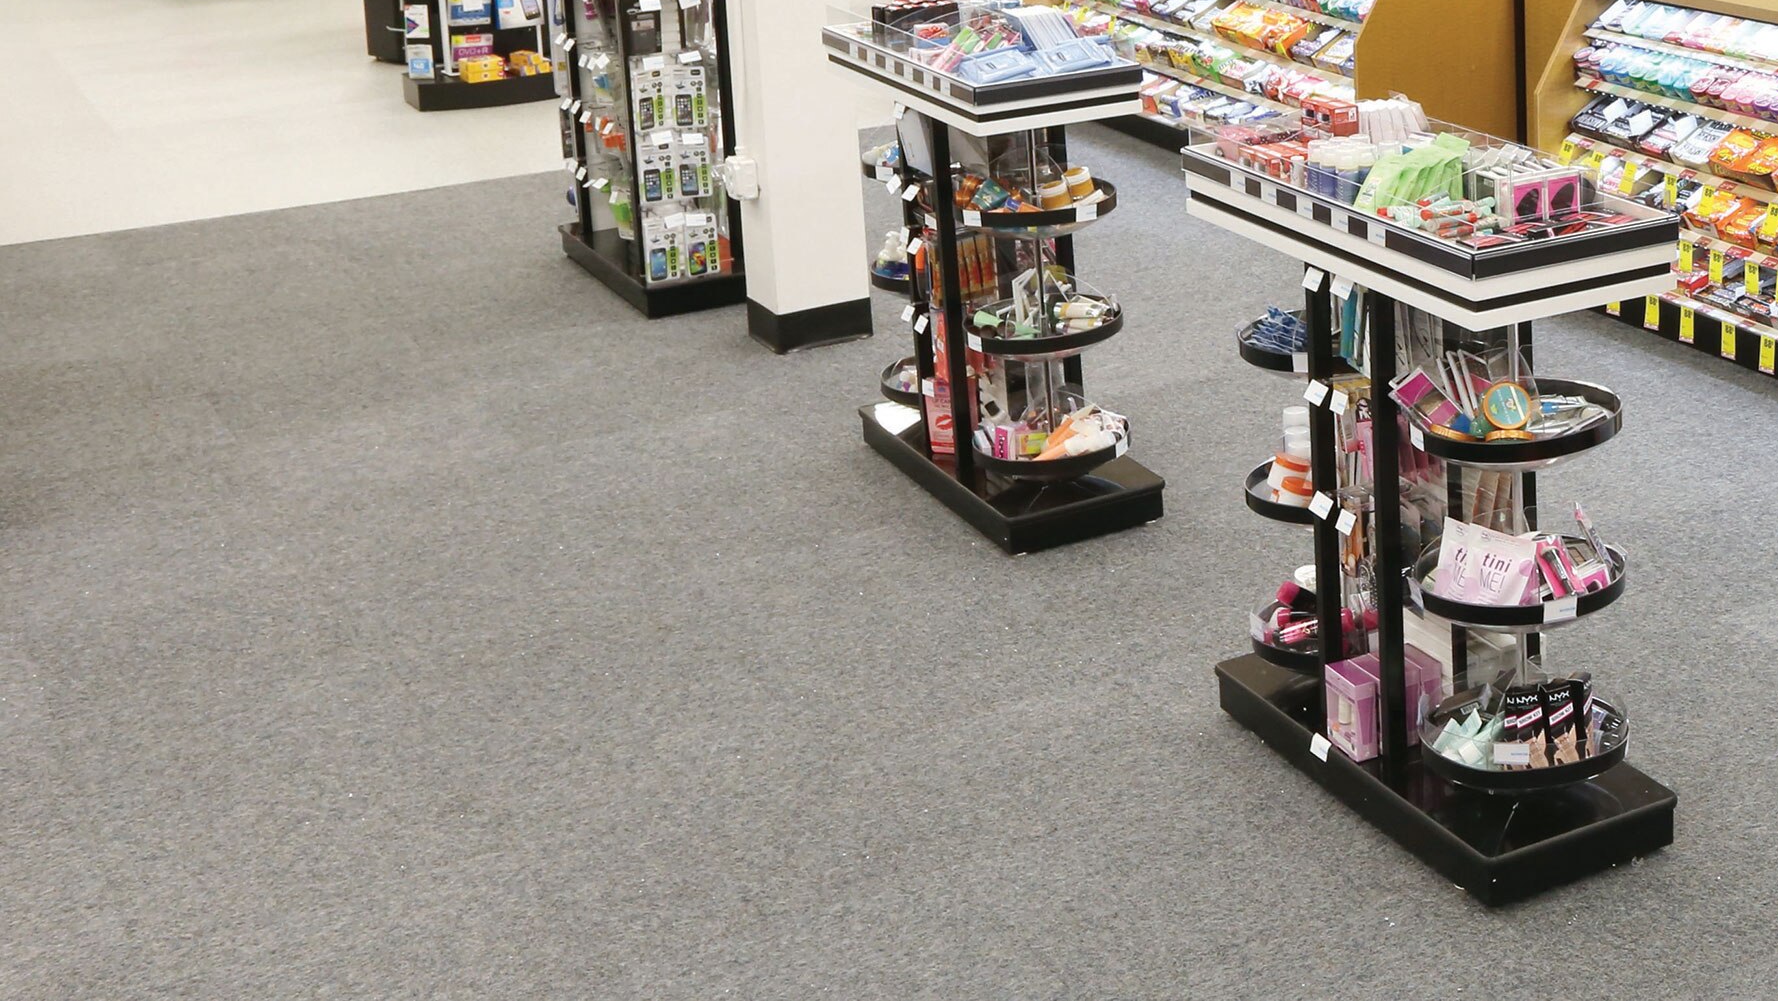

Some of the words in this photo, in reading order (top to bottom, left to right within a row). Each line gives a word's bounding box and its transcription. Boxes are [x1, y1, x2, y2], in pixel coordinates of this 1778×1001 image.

[1482, 553, 1513, 574] tini
[1479, 569, 1506, 594] ME!
[1517, 695, 1539, 705] NYX
[1549, 690, 1570, 702] NYX
